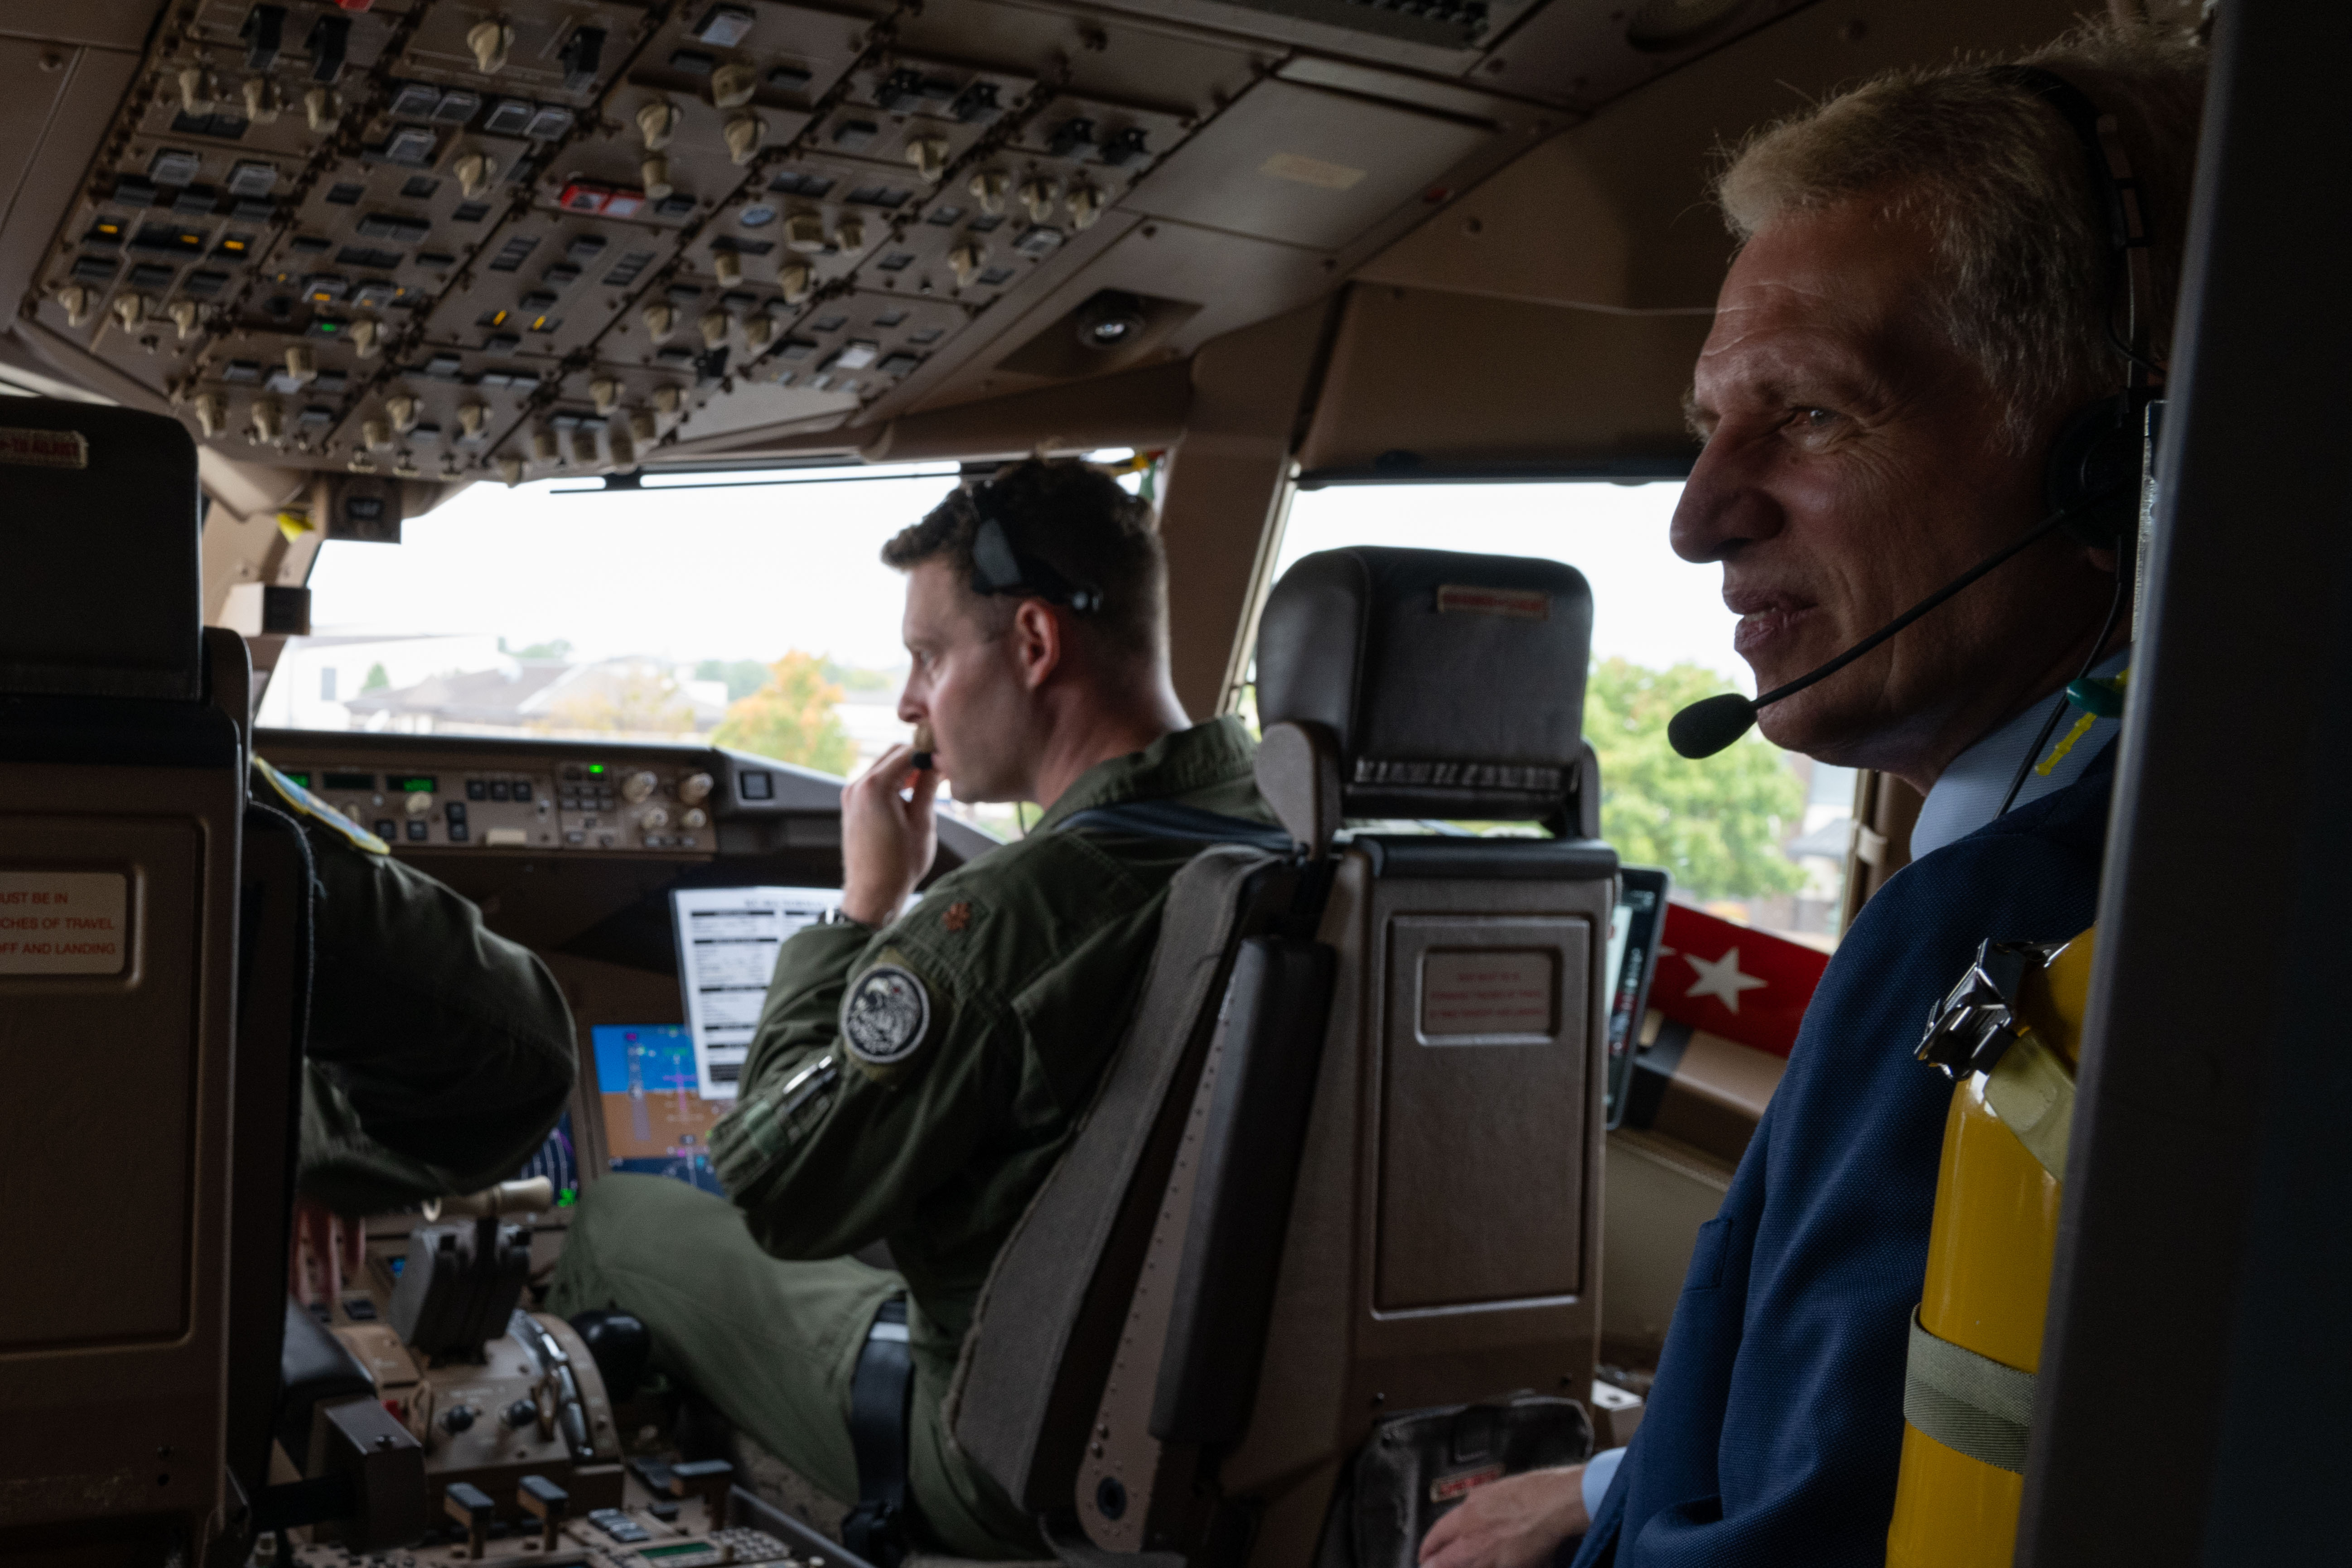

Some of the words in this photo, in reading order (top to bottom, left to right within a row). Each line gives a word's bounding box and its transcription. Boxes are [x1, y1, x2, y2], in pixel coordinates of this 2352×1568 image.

[0, 892, 28, 904] UST
[32, 892, 49, 904] BE
[54, 893, 68, 904] IN
[0, 917, 38, 929] CHES
[42, 917, 59, 929] OF
[65, 917, 114, 930] TRAVEL
[0, 942, 18, 954] FF
[23, 943, 52, 955] AND
[55, 943, 116, 955] LANDING
